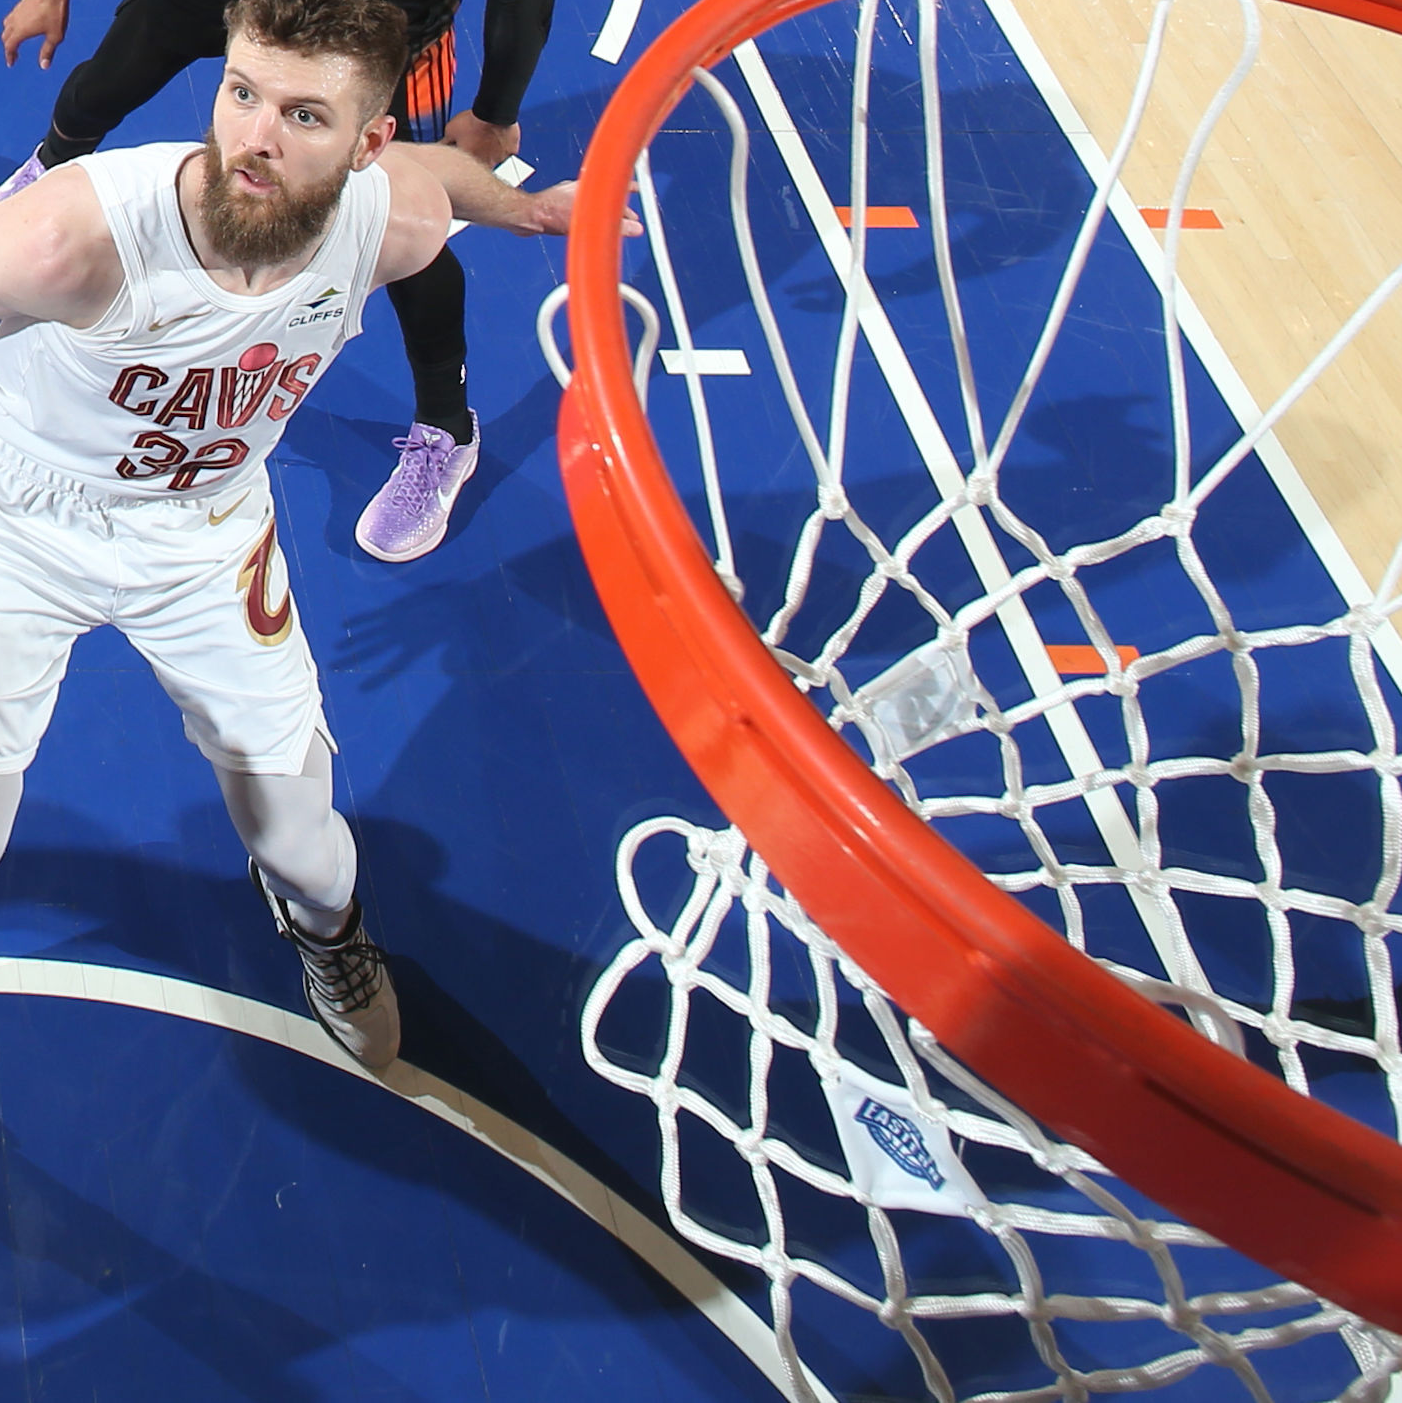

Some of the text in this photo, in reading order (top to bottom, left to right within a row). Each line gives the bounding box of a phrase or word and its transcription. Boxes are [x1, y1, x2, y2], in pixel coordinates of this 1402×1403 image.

[288, 307, 344, 328] CLIFFS
[108, 352, 323, 430] CAVS
[115, 431, 251, 491] 32
